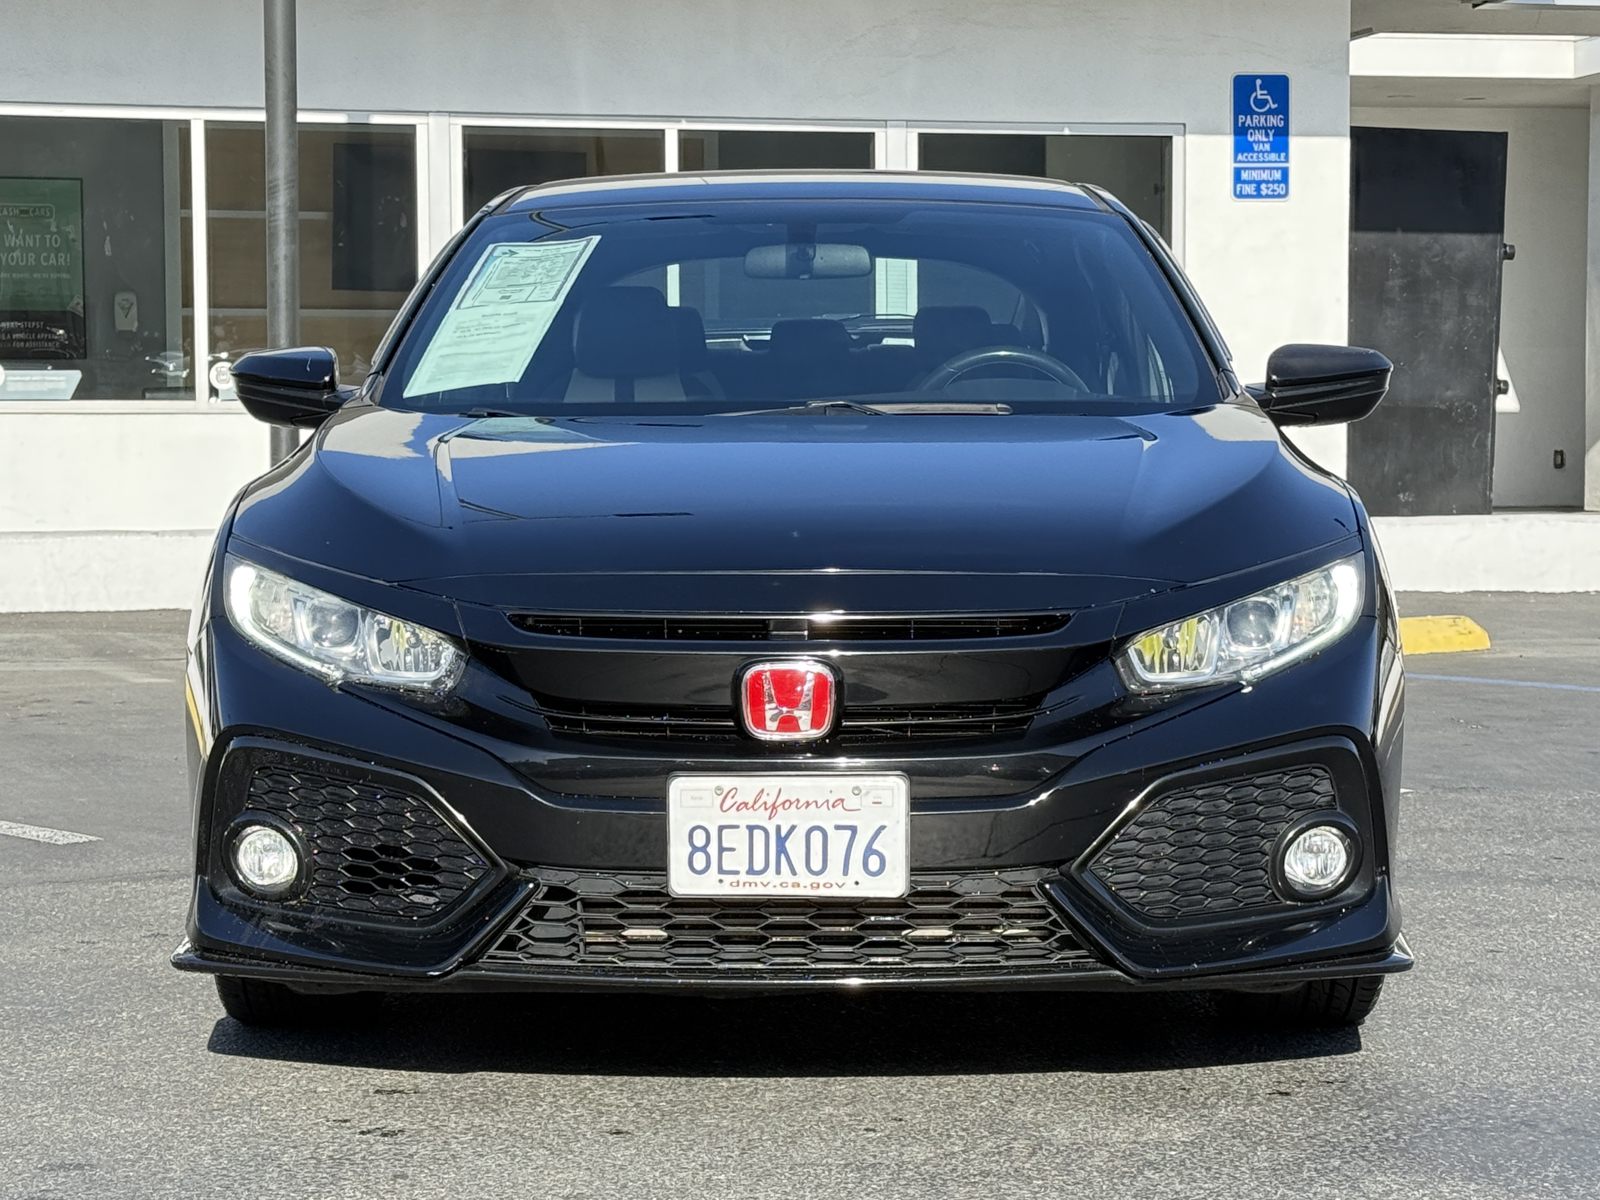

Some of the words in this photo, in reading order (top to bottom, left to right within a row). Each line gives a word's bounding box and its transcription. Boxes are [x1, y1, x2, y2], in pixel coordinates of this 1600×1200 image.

[1238, 115, 1284, 127] PARKING
[1247, 129, 1275, 142] ONLY
[1252, 142, 1270, 151] VAN
[1237, 152, 1286, 161] ACCESSIBLE
[1240, 169, 1282, 181] MINIMUM
[1236, 183, 1257, 195] FINE
[1260, 183, 1286, 195] $250
[29, 207, 51, 217] CARS
[3, 234, 41, 248] WANT
[44, 234, 61, 248] TO
[0, 252, 36, 266] YOUR
[40, 252, 71, 266] CAR!
[719, 787, 861, 820] California
[687, 824, 888, 877] 8EDK076
[729, 878, 846, 890] dmv.ca.gov
